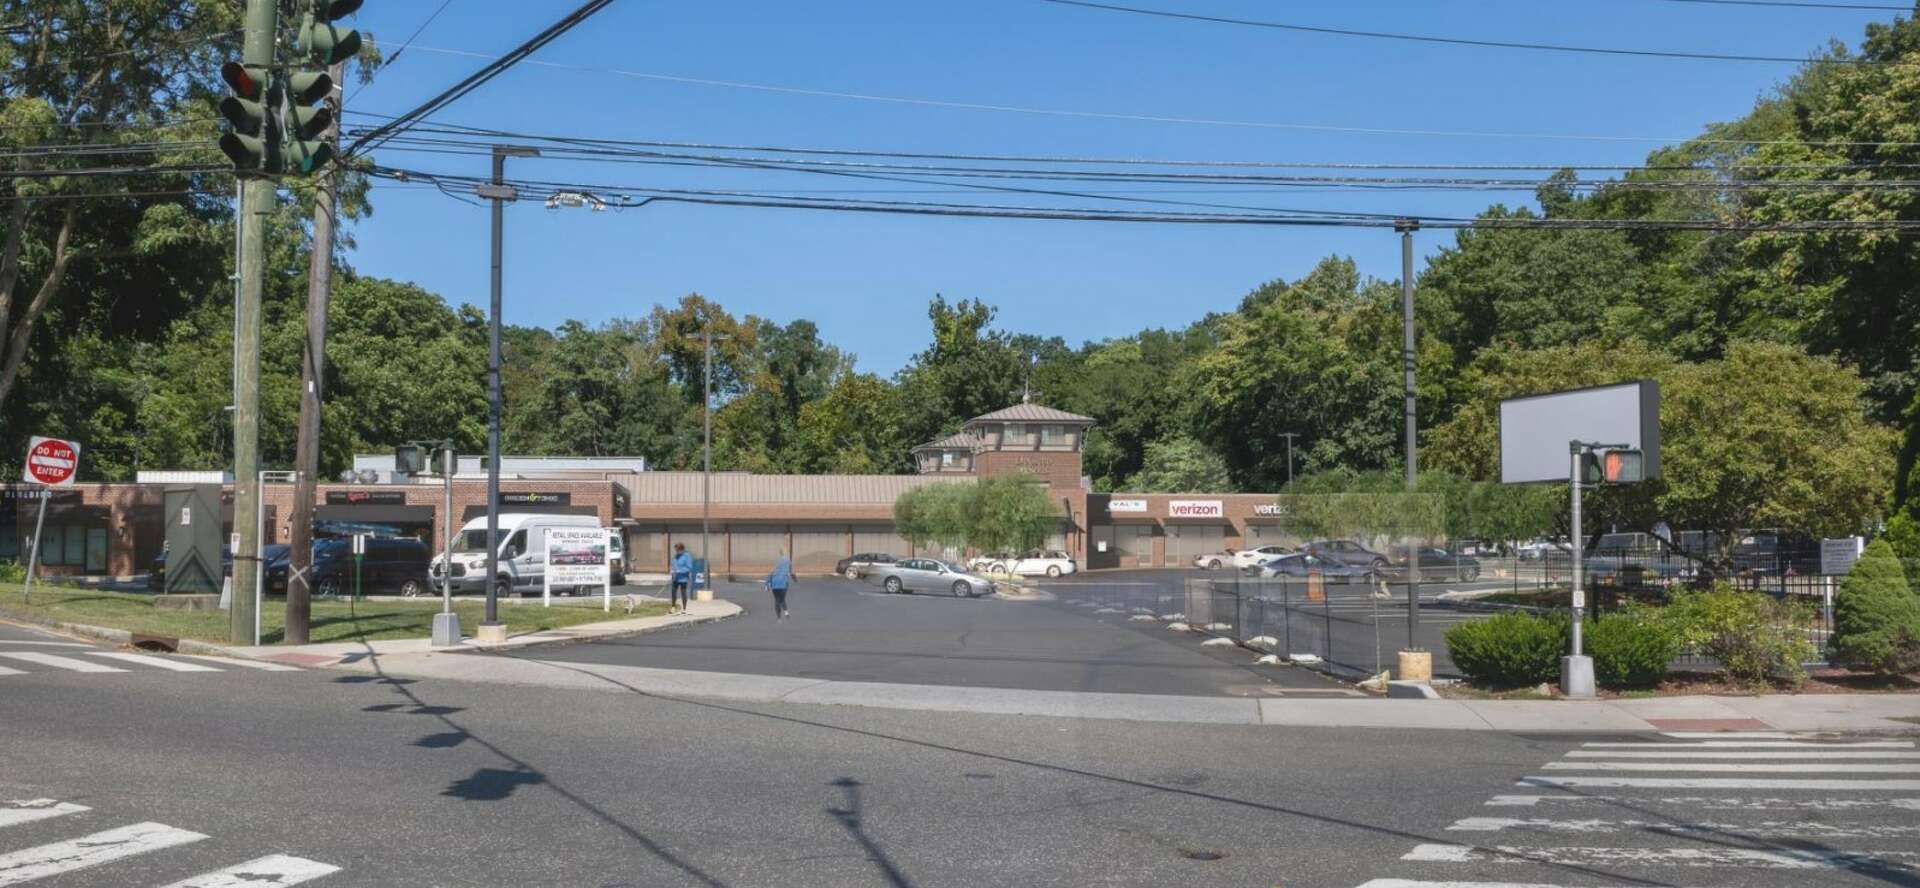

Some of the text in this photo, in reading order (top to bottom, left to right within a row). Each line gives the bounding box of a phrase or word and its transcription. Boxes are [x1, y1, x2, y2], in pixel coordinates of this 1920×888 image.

[37, 447, 72, 458] DO NOT
[37, 467, 65, 477] ENTER
[1171, 503, 1218, 515] verizon
